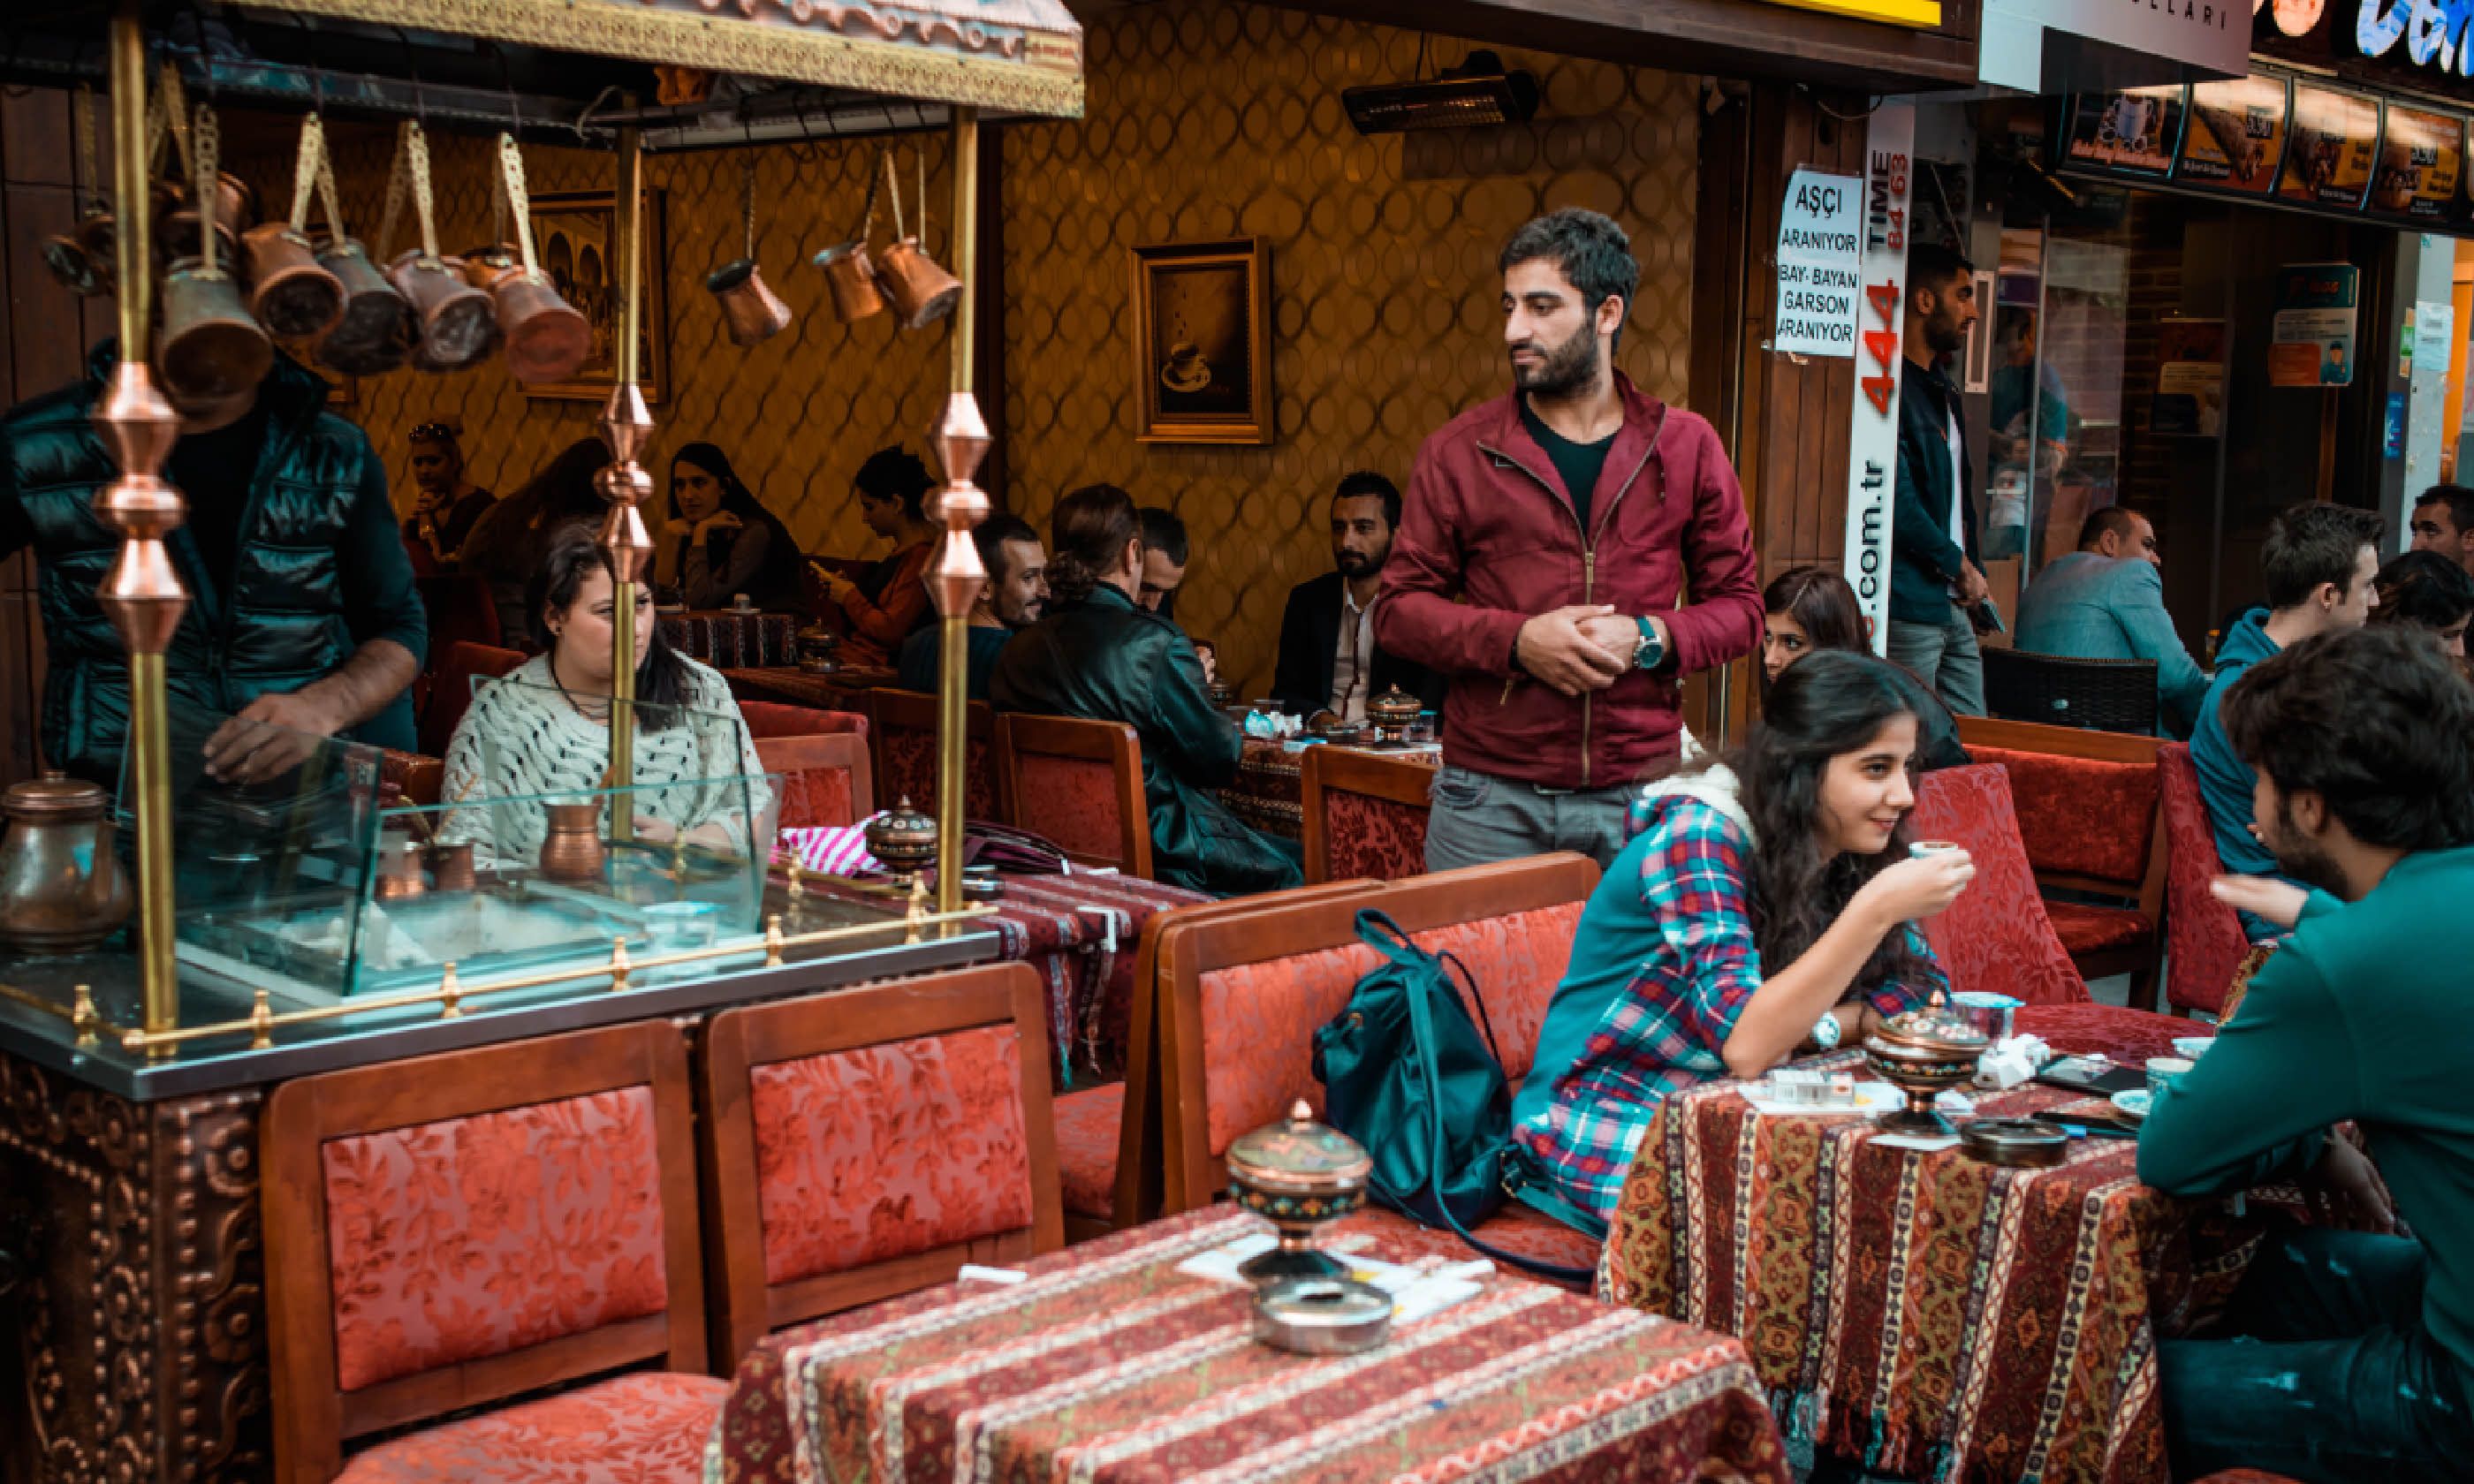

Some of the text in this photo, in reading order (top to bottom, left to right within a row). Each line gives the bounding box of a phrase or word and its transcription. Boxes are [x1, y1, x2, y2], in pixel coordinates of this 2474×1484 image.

[2131, 0, 2227, 30] LLARI
[1795, 184, 1842, 219] AŞÇI
[1866, 150, 1891, 253] TIME
[1781, 228, 1856, 254] ARANIYOR
[1861, 154, 1909, 415] 444 84 63
[1785, 290, 1850, 316] GARSON
